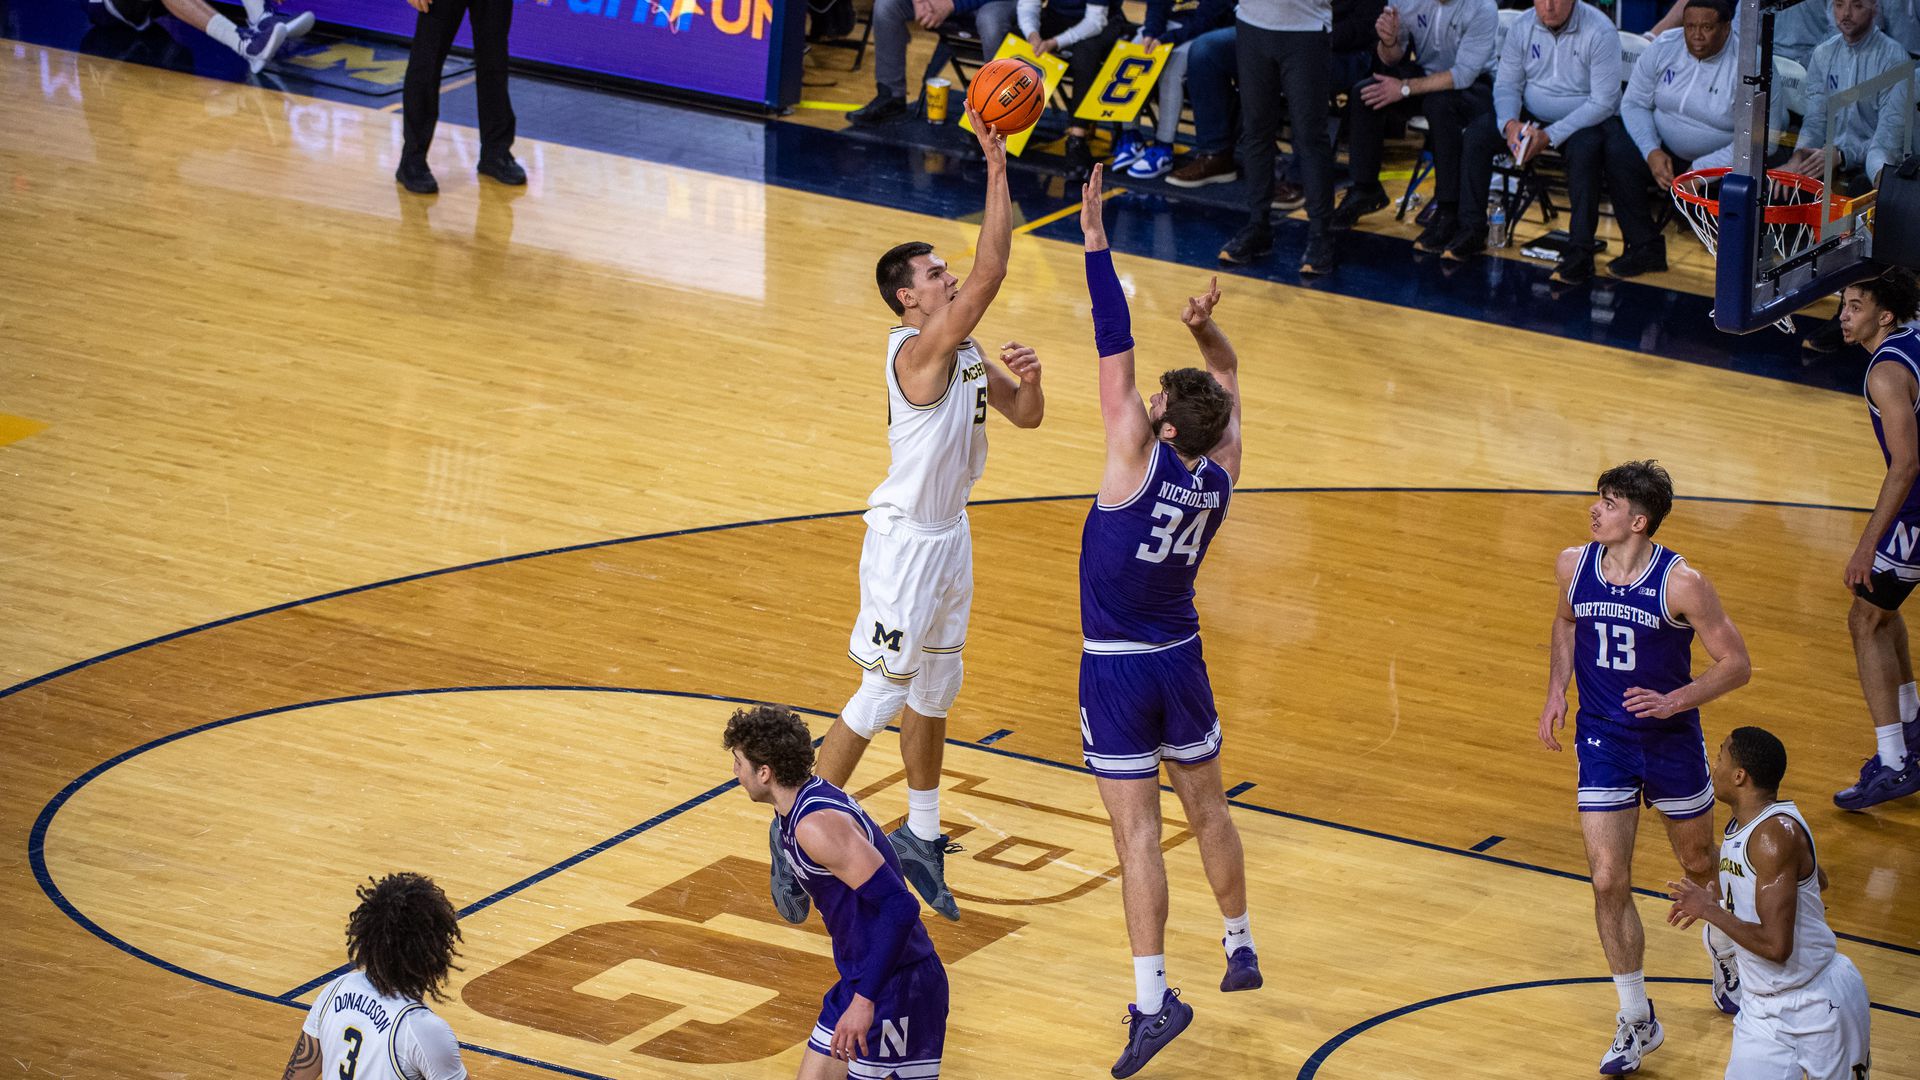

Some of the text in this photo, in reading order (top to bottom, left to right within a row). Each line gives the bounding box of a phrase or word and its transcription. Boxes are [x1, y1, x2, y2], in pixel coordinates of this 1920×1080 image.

[1416, 14, 1427, 28] N
[1531, 44, 1541, 59] N
[1663, 69, 1675, 85] N
[1829, 74, 1839, 89] N
[1157, 480, 1220, 509] NICHOLSON
[1135, 501, 1211, 566] 34
[1886, 520, 1920, 561] N
[1573, 601, 1660, 630] NORTHWESTERN
[872, 620, 904, 652] M
[1594, 621, 1636, 671] 13
[334, 992, 391, 1034] DONALDSON
[879, 1015, 909, 1058] N
[338, 1026, 364, 1080] 3
